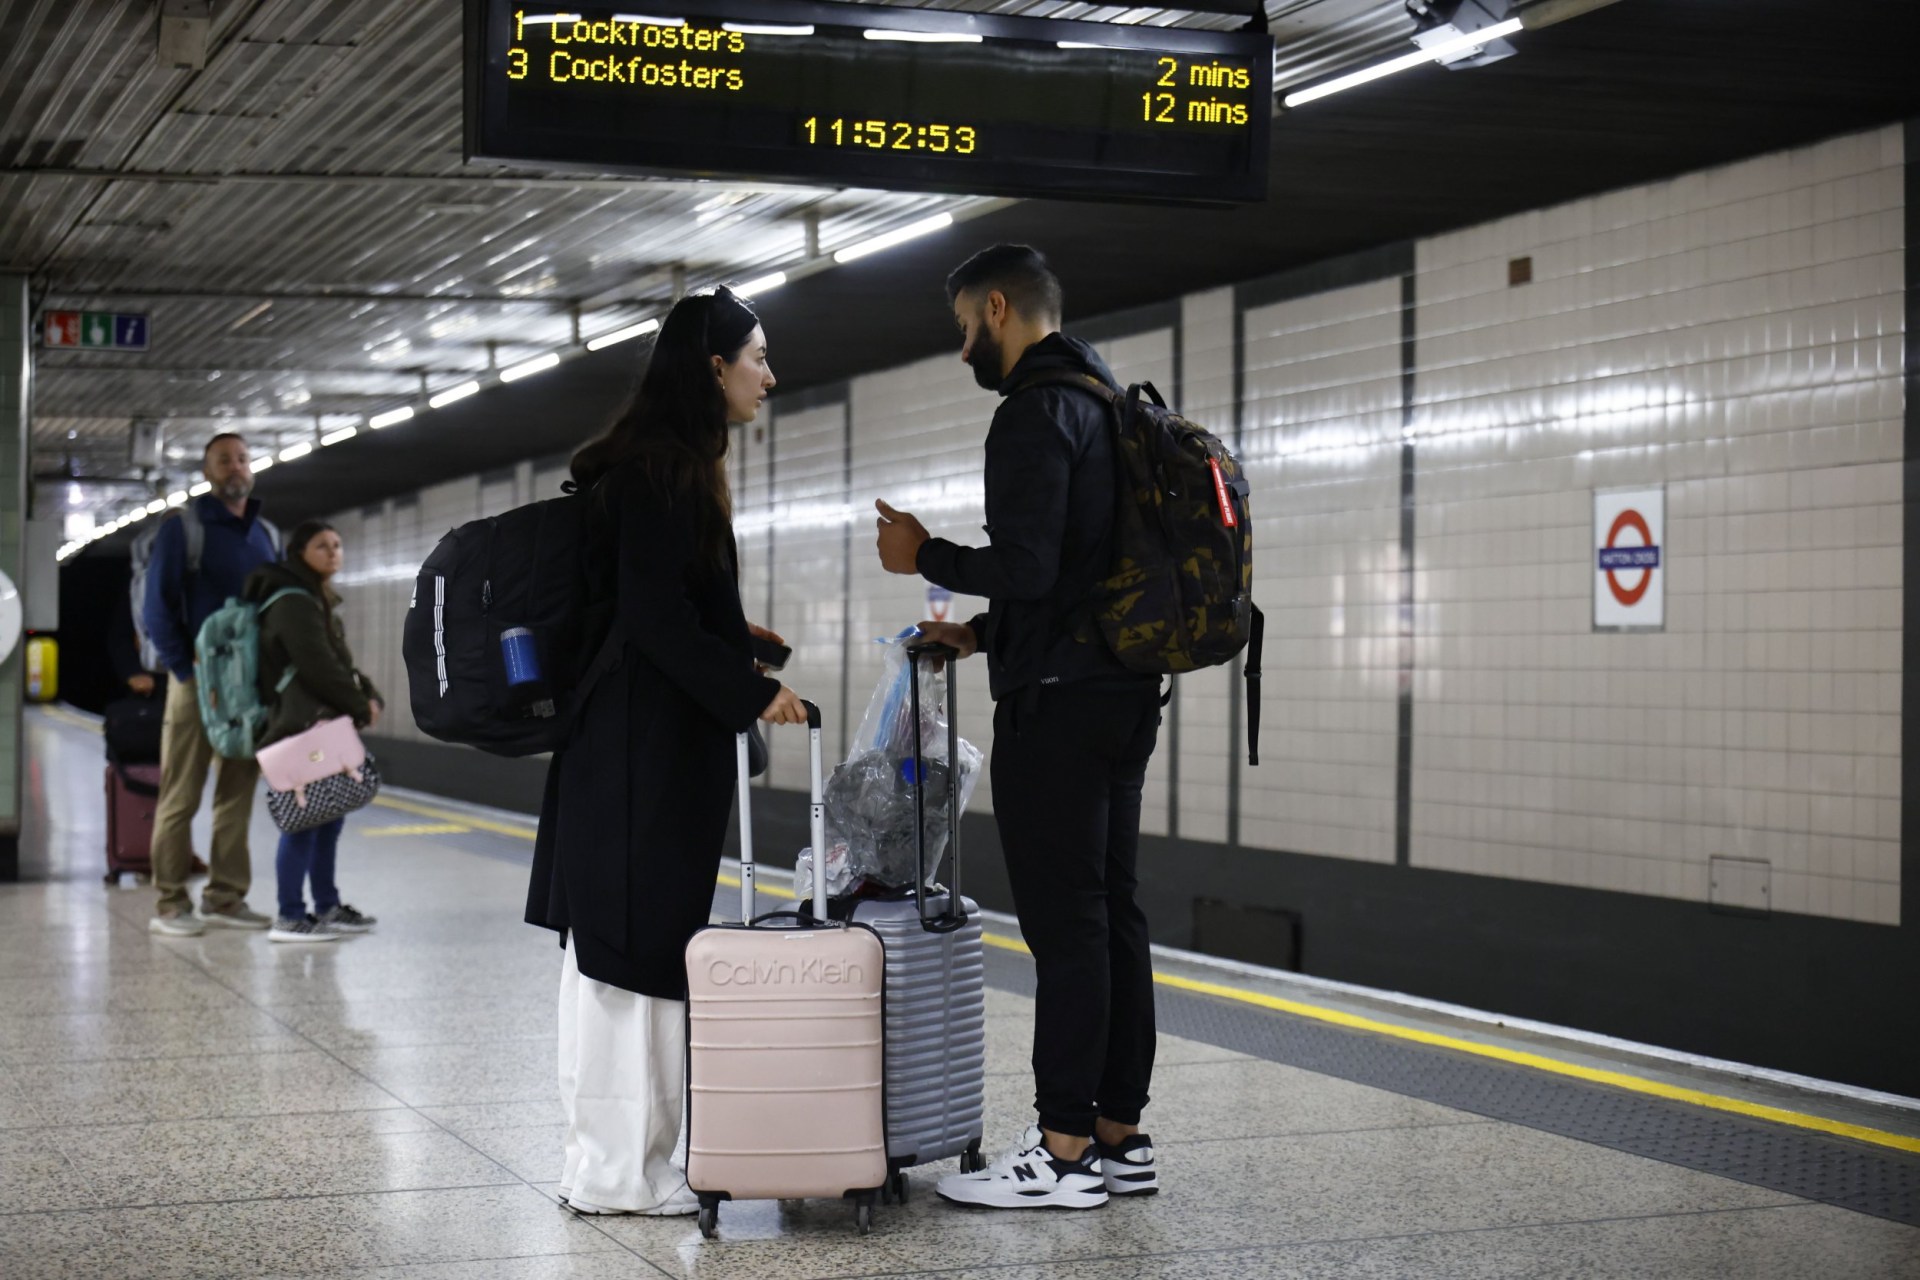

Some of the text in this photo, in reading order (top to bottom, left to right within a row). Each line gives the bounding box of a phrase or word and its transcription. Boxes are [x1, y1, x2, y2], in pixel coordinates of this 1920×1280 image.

[515, 10, 1250, 89] 1 Cockfosters 2 mins
[507, 48, 1249, 125] 3 Cockfosters 12 mins
[804, 117, 976, 154] 11:52:53
[709, 958, 864, 987] Calvin Klein
[1012, 1163, 1039, 1183] N
